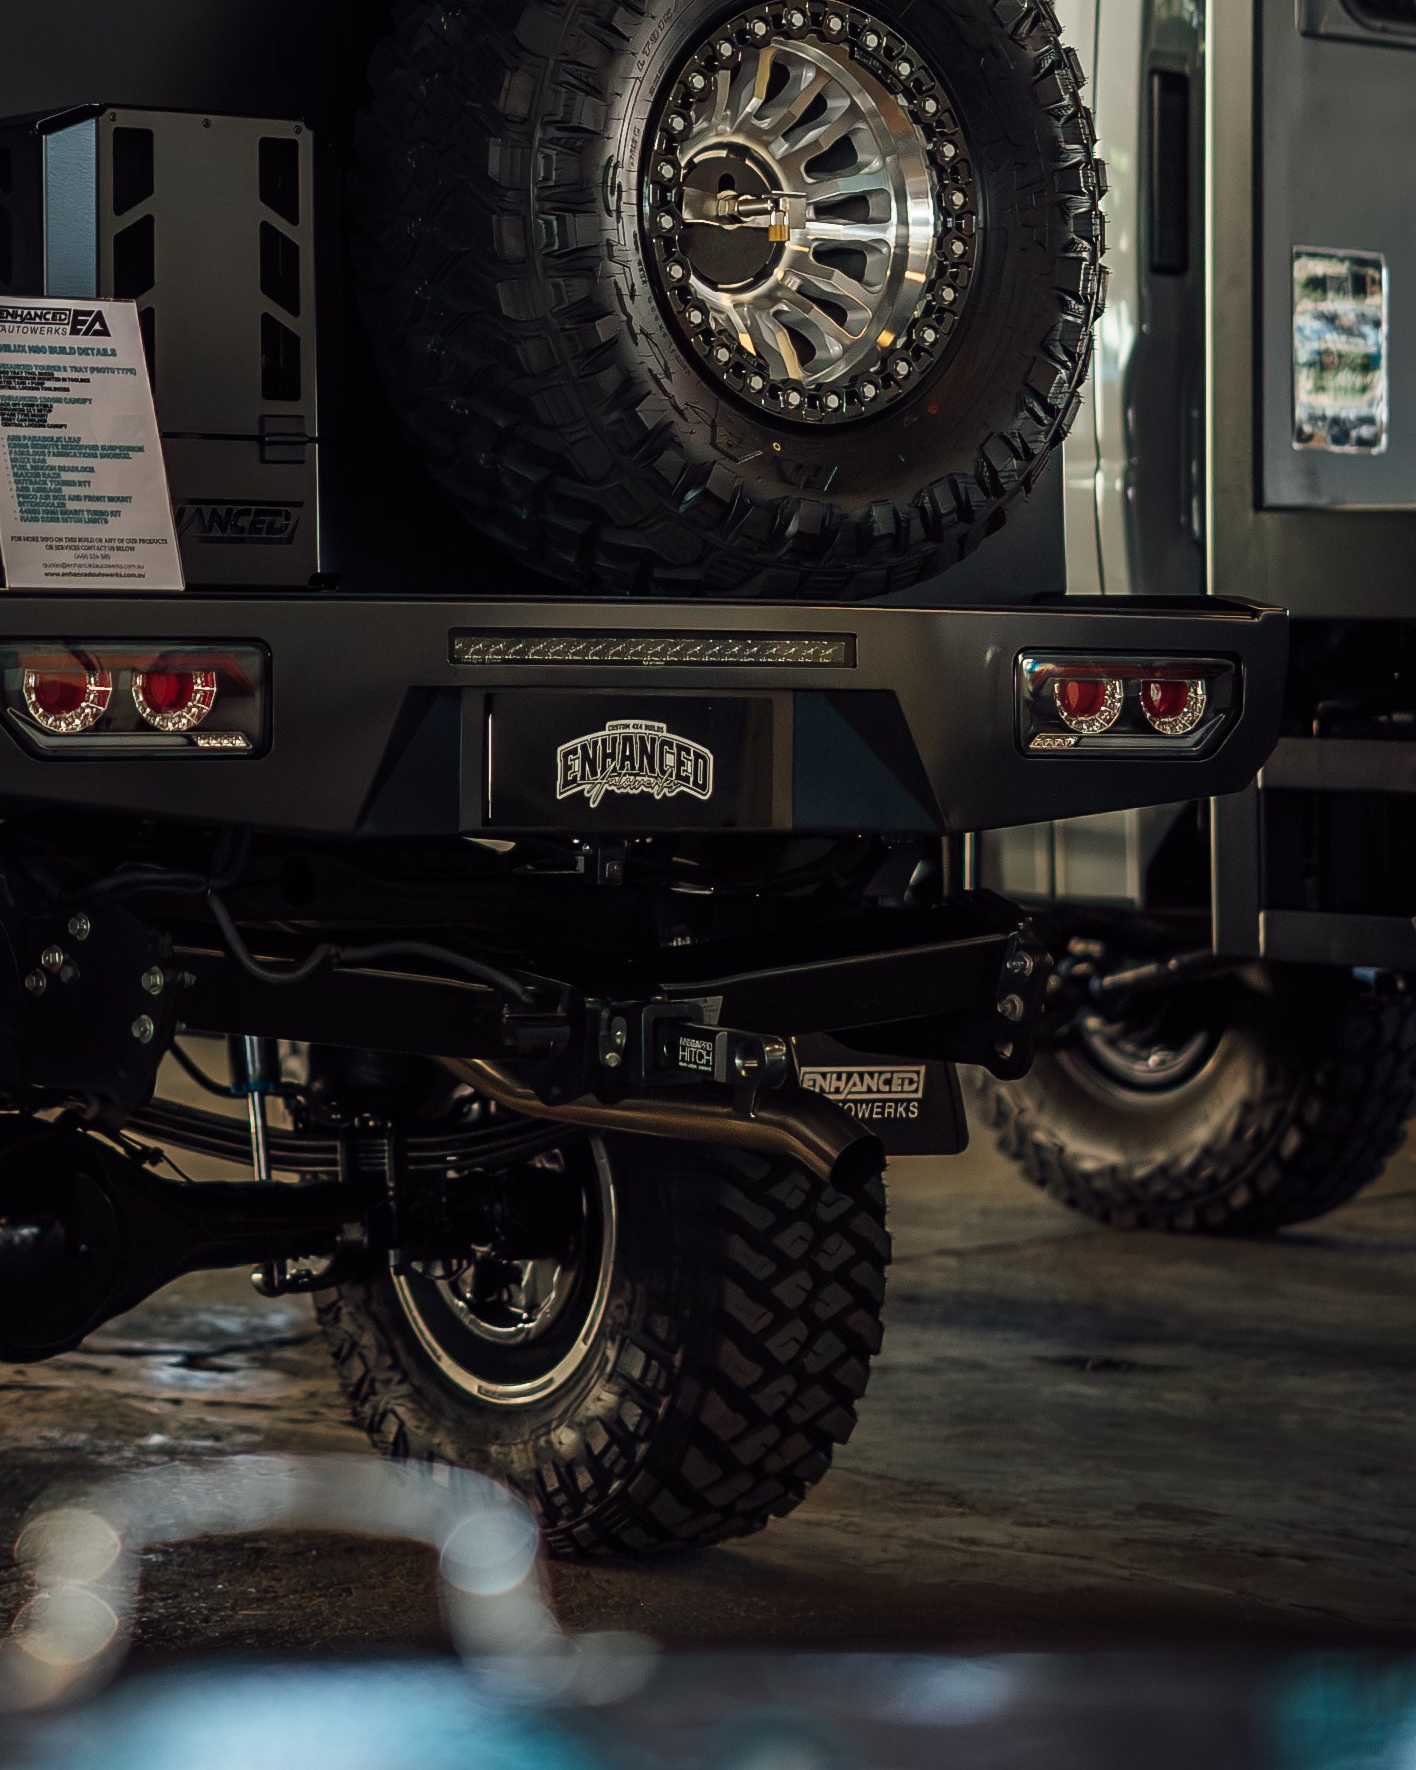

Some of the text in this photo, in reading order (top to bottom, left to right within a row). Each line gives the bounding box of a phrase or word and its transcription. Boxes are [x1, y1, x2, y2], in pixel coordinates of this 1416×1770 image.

[0, 325, 68, 336] AUTOWERKS
[559, 732, 711, 796] ENHANCED
[679, 1045, 713, 1066] HITCH
[803, 1070, 919, 1093] ENHANCED
[836, 1102, 919, 1119] OWERKS
